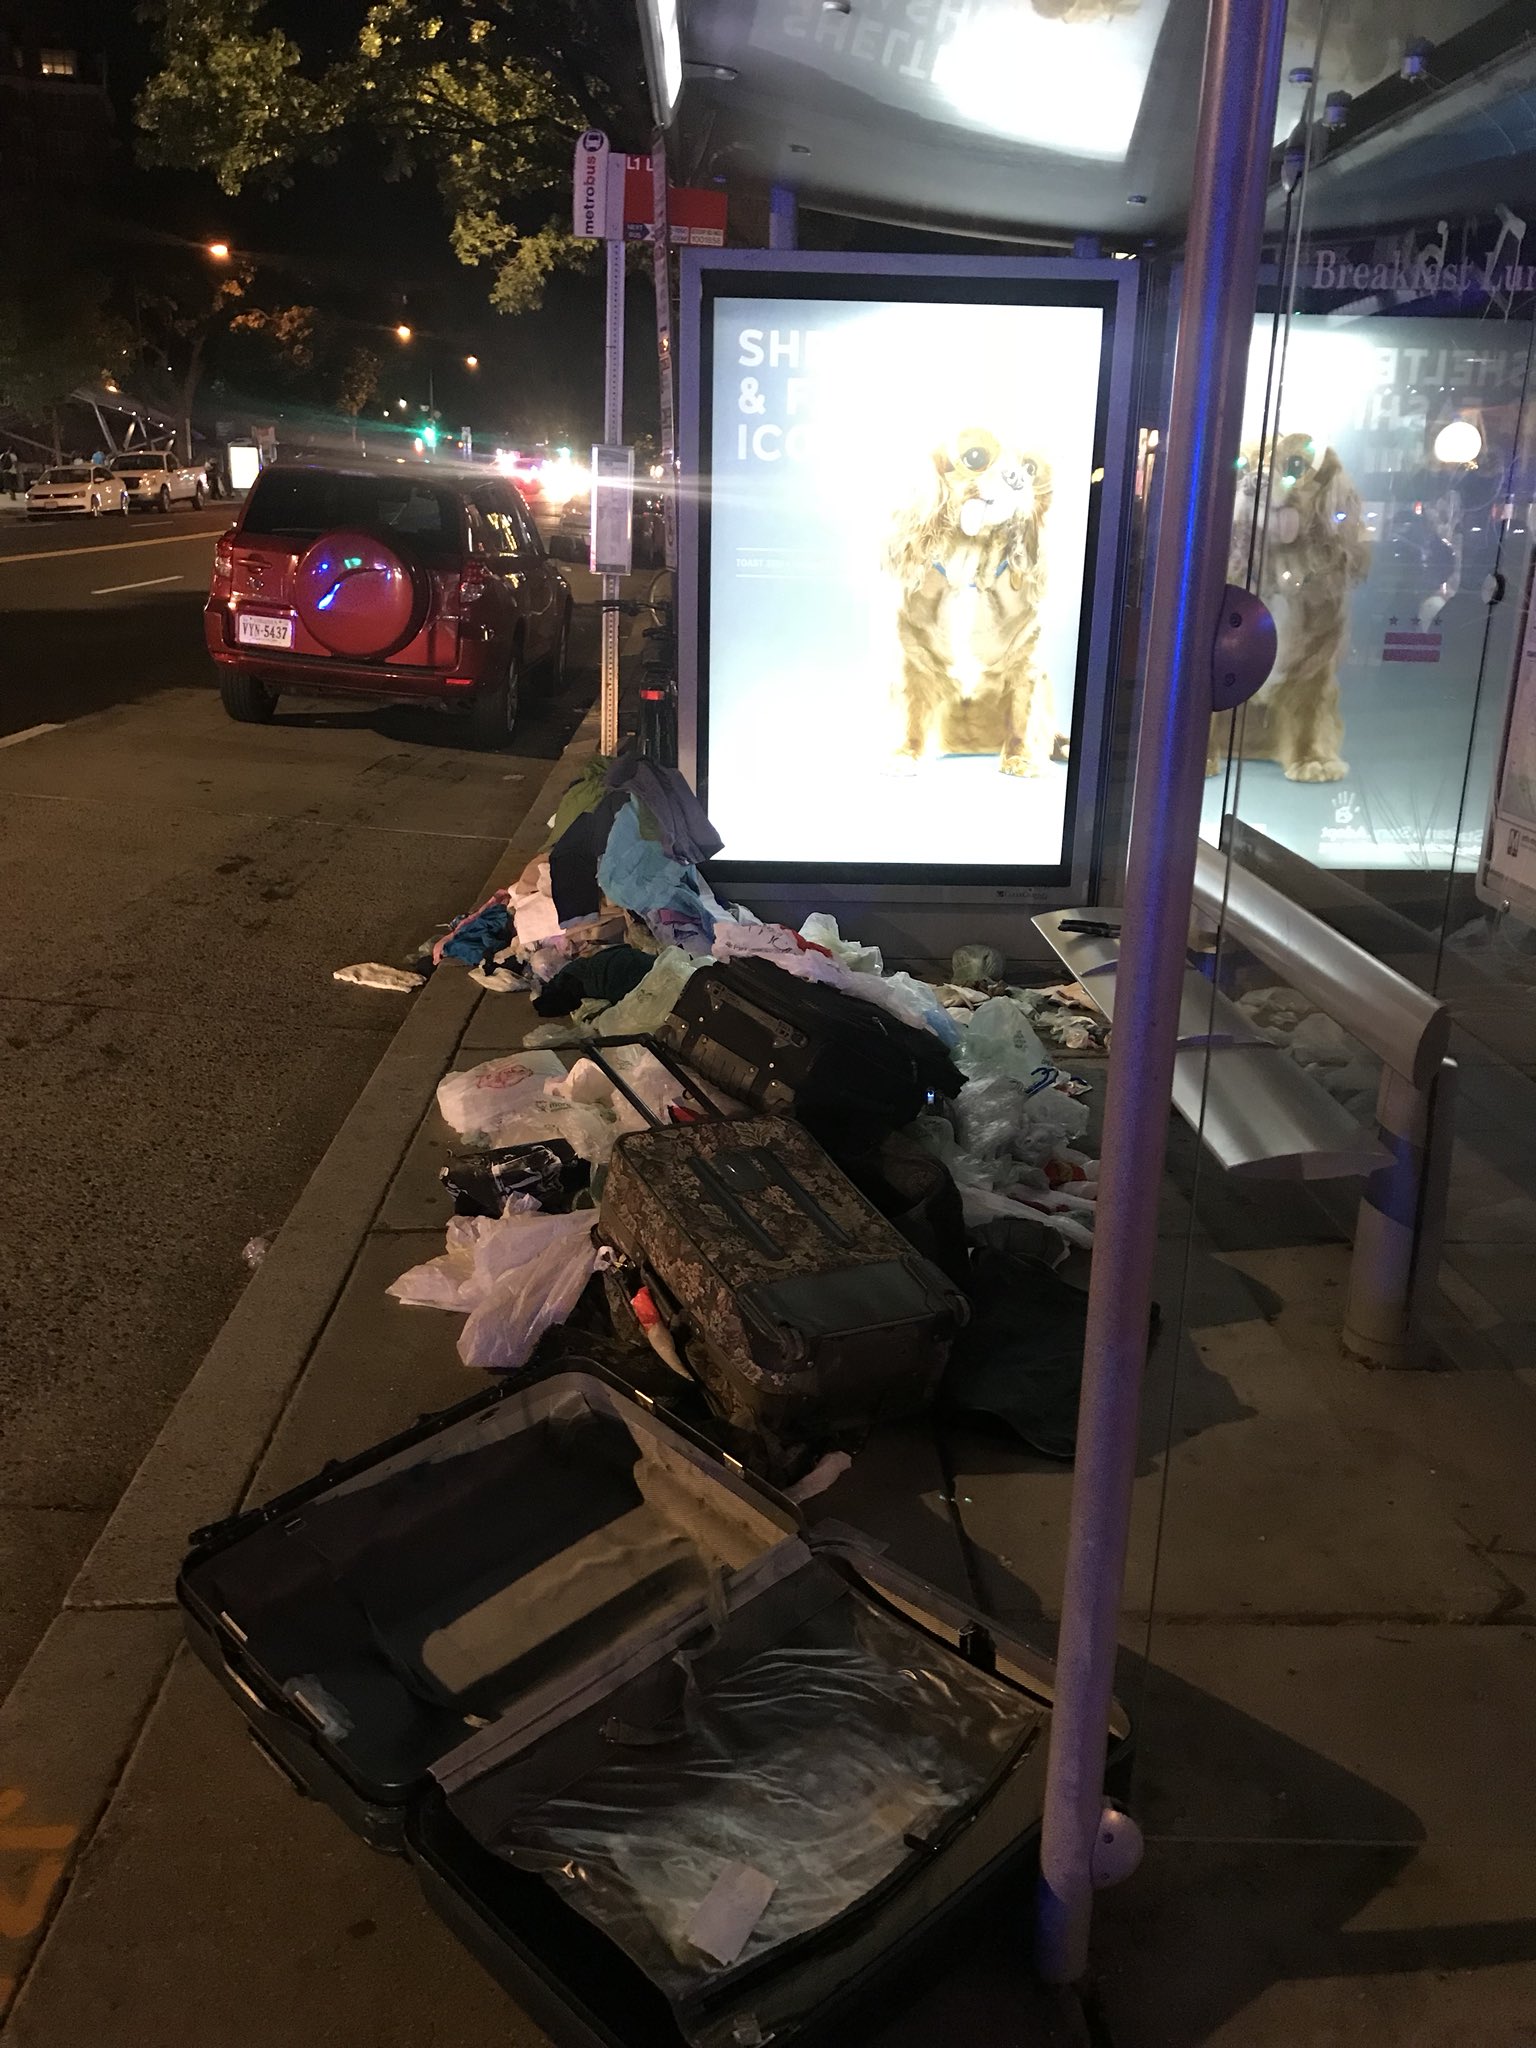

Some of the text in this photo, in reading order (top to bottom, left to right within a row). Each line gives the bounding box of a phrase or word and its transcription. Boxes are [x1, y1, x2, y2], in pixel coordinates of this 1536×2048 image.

[626, 157, 641, 171] L1
[583, 155, 597, 235] metrobus
[737, 376, 767, 416] &
[242, 621, 289, 641] VYN-5437
